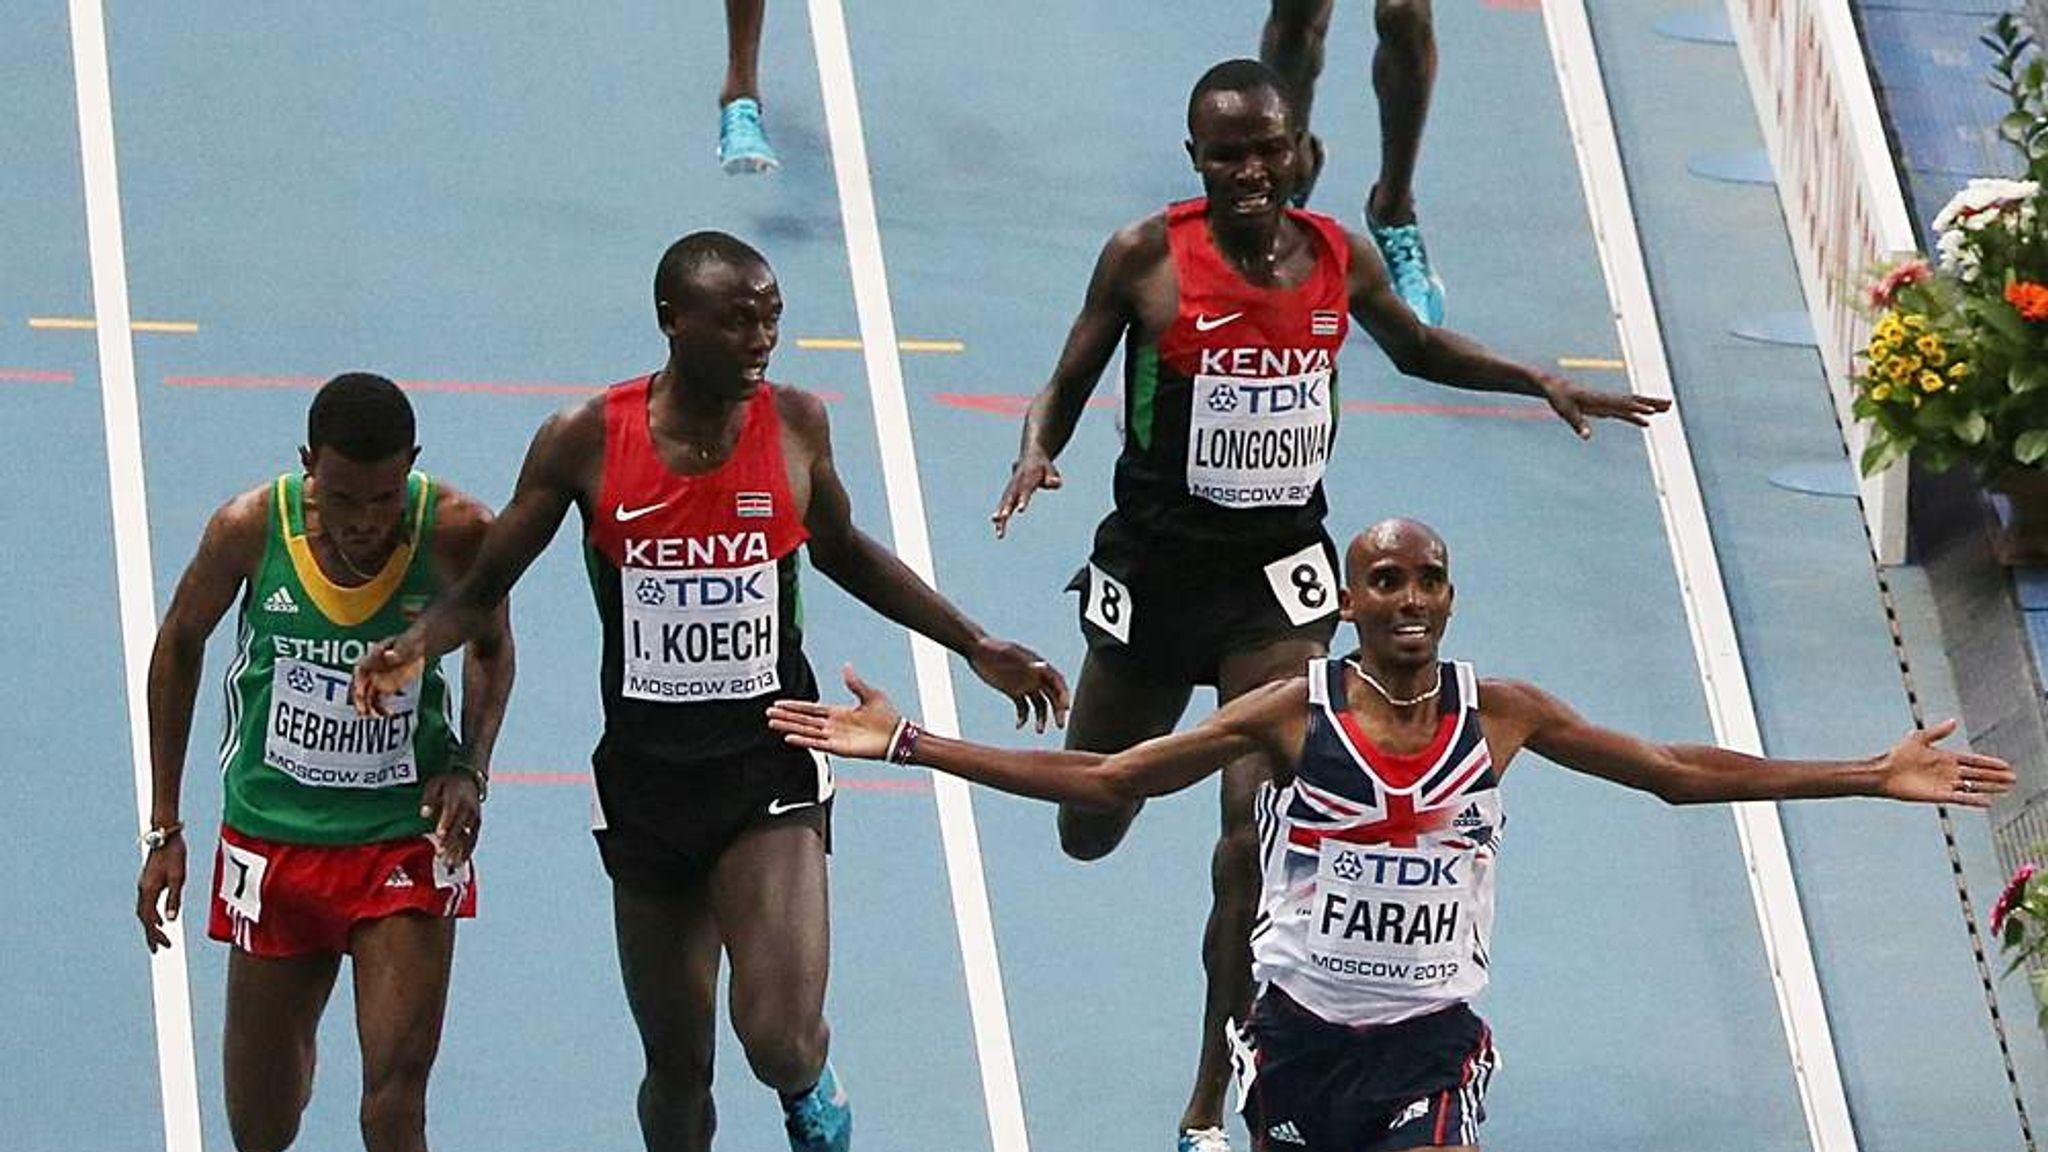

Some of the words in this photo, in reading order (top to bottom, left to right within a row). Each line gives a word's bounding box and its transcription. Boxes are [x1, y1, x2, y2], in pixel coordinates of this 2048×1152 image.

[1200, 348, 1333, 376] KENYA
[1239, 379, 1322, 415] TDK
[1195, 423, 1327, 470] LONGOSIWA
[1193, 484, 1285, 503] MOSCOW
[624, 532, 770, 567] KENYA
[665, 571, 766, 607] TDK
[1100, 579, 1122, 626] 8
[1290, 563, 1327, 609] 8
[273, 635, 374, 665] ETHIO
[632, 619, 651, 661] I.
[661, 614, 772, 664] KOECH
[629, 676, 726, 697] MOSCOW
[730, 671, 775, 694] 2013
[275, 702, 413, 754] GEBRHIWET
[268, 752, 358, 784] MOSCOW
[362, 764, 411, 784] 2013
[229, 855, 250, 900] 7
[1364, 852, 1462, 886] TDK
[1320, 892, 1460, 946] FARAH
[1310, 953, 1410, 979] MOSCOW
[1413, 962, 1460, 981] 2013
